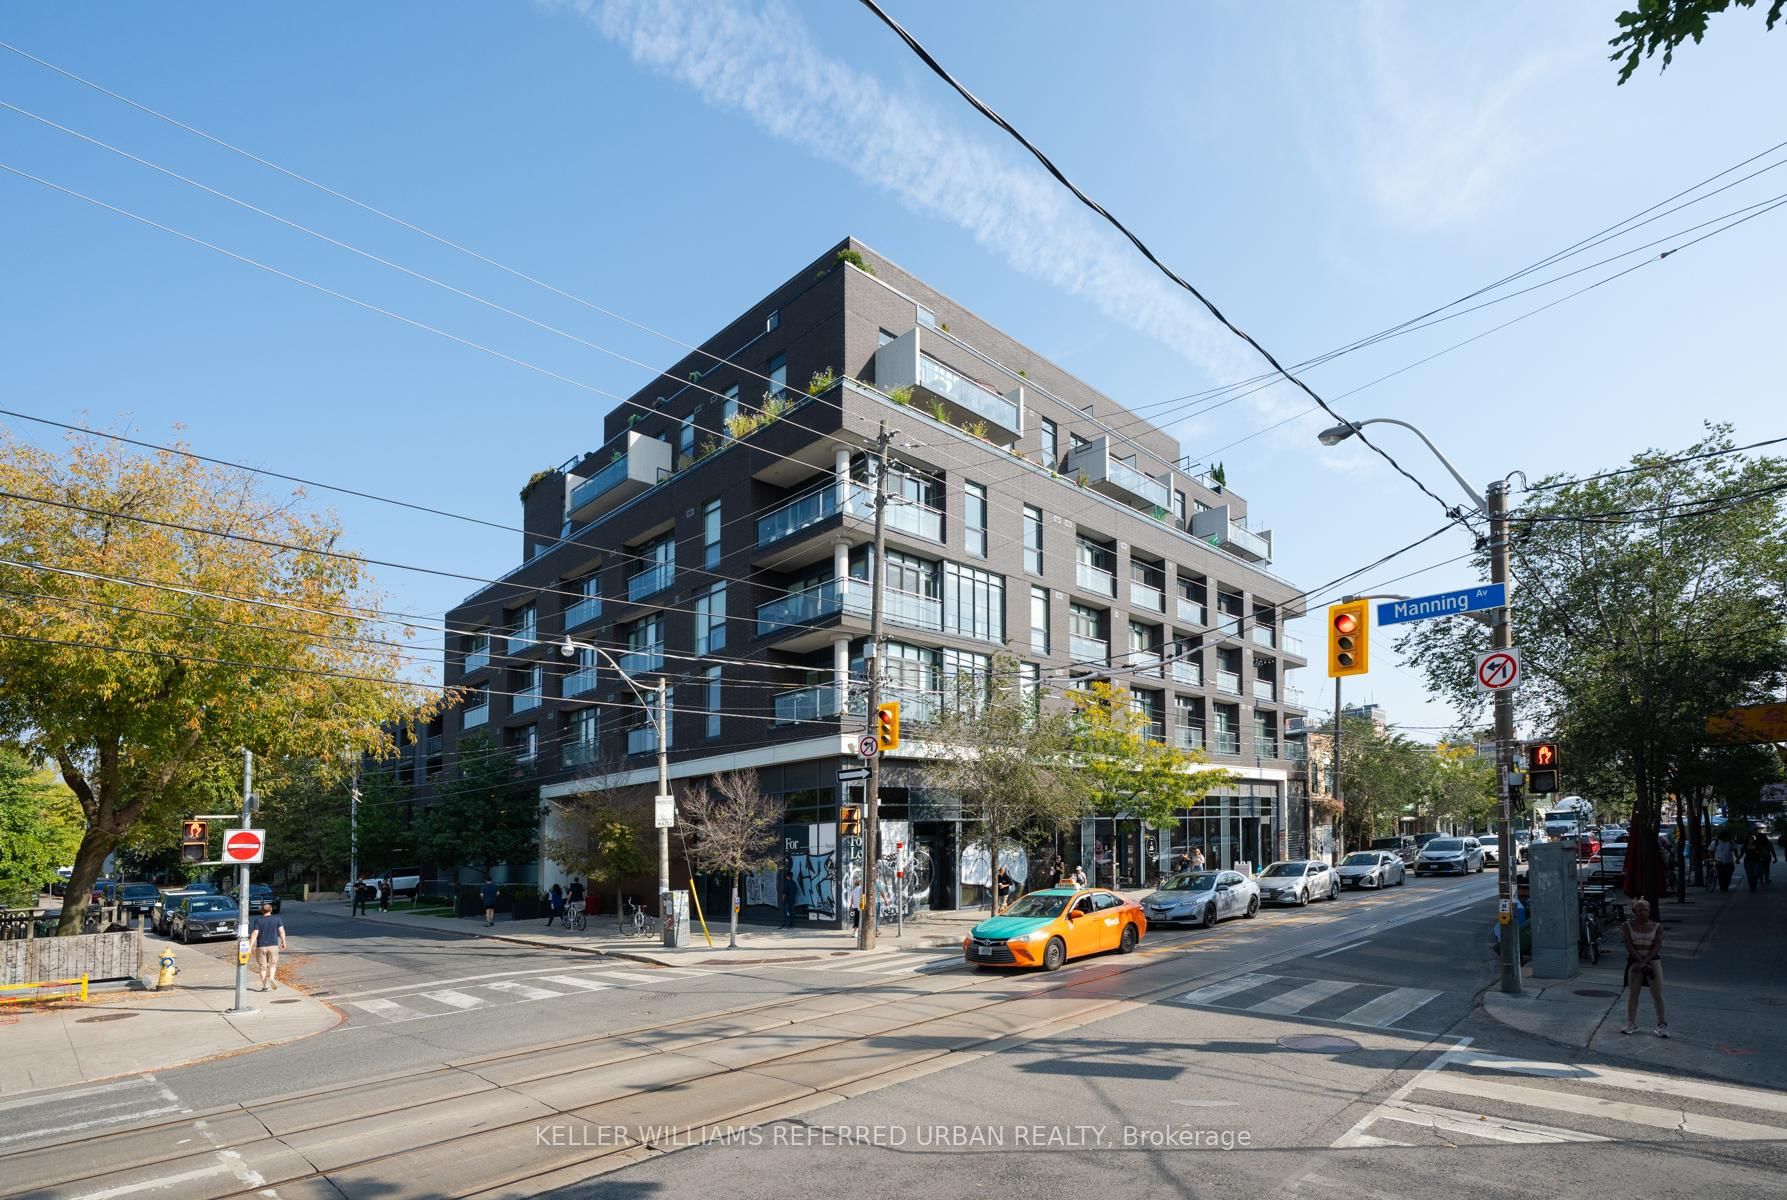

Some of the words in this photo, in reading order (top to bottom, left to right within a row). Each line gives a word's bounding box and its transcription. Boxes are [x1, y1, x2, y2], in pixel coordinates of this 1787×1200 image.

[1394, 594, 1469, 618] Manning
[1476, 589, 1488, 598] Av
[785, 837, 799, 850] For
